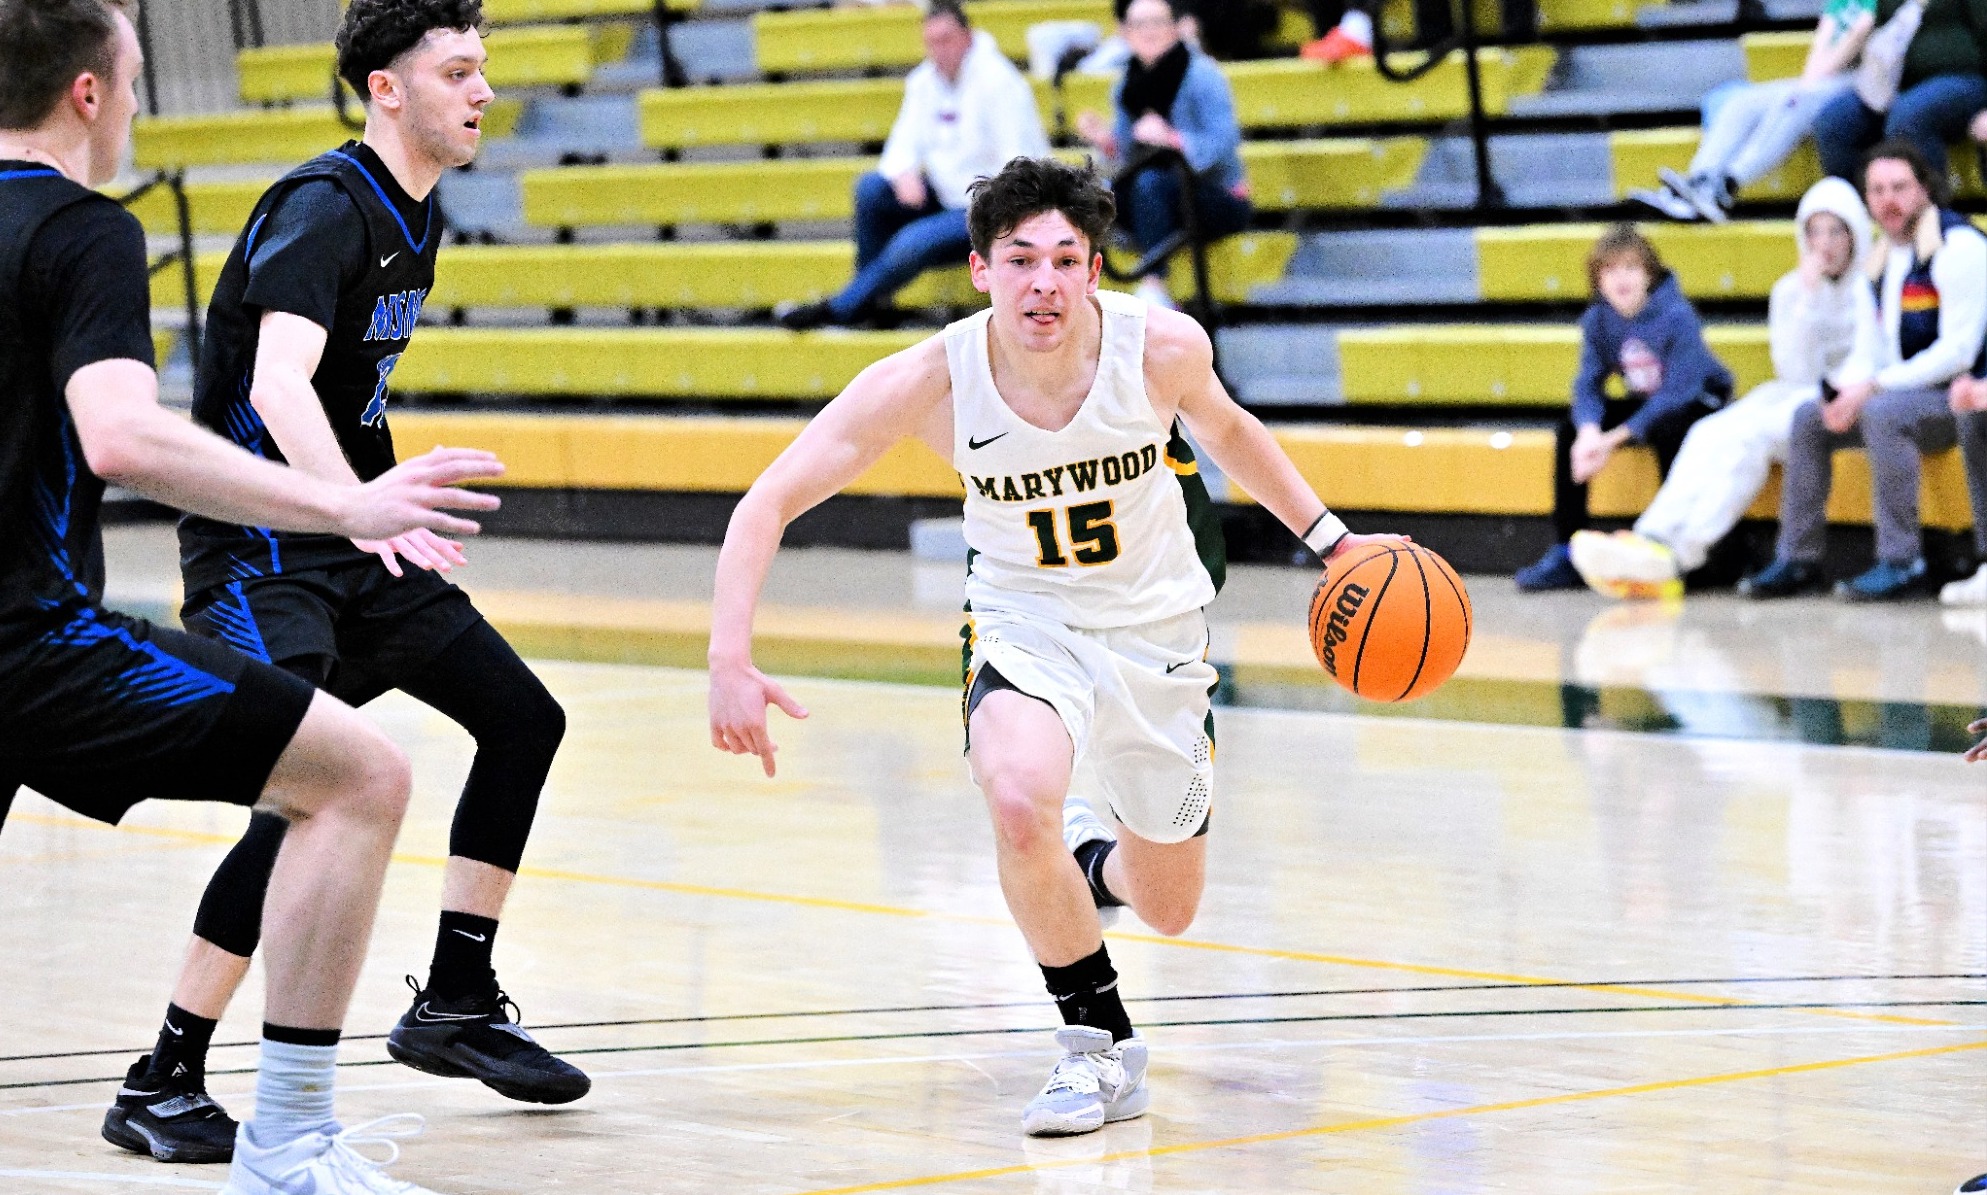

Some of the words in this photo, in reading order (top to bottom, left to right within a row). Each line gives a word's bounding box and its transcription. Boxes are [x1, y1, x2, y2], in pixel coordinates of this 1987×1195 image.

[970, 443, 1157, 502] MARYWOOD
[1025, 499, 1121, 568] 15
[1323, 582, 1370, 677] Wilson
